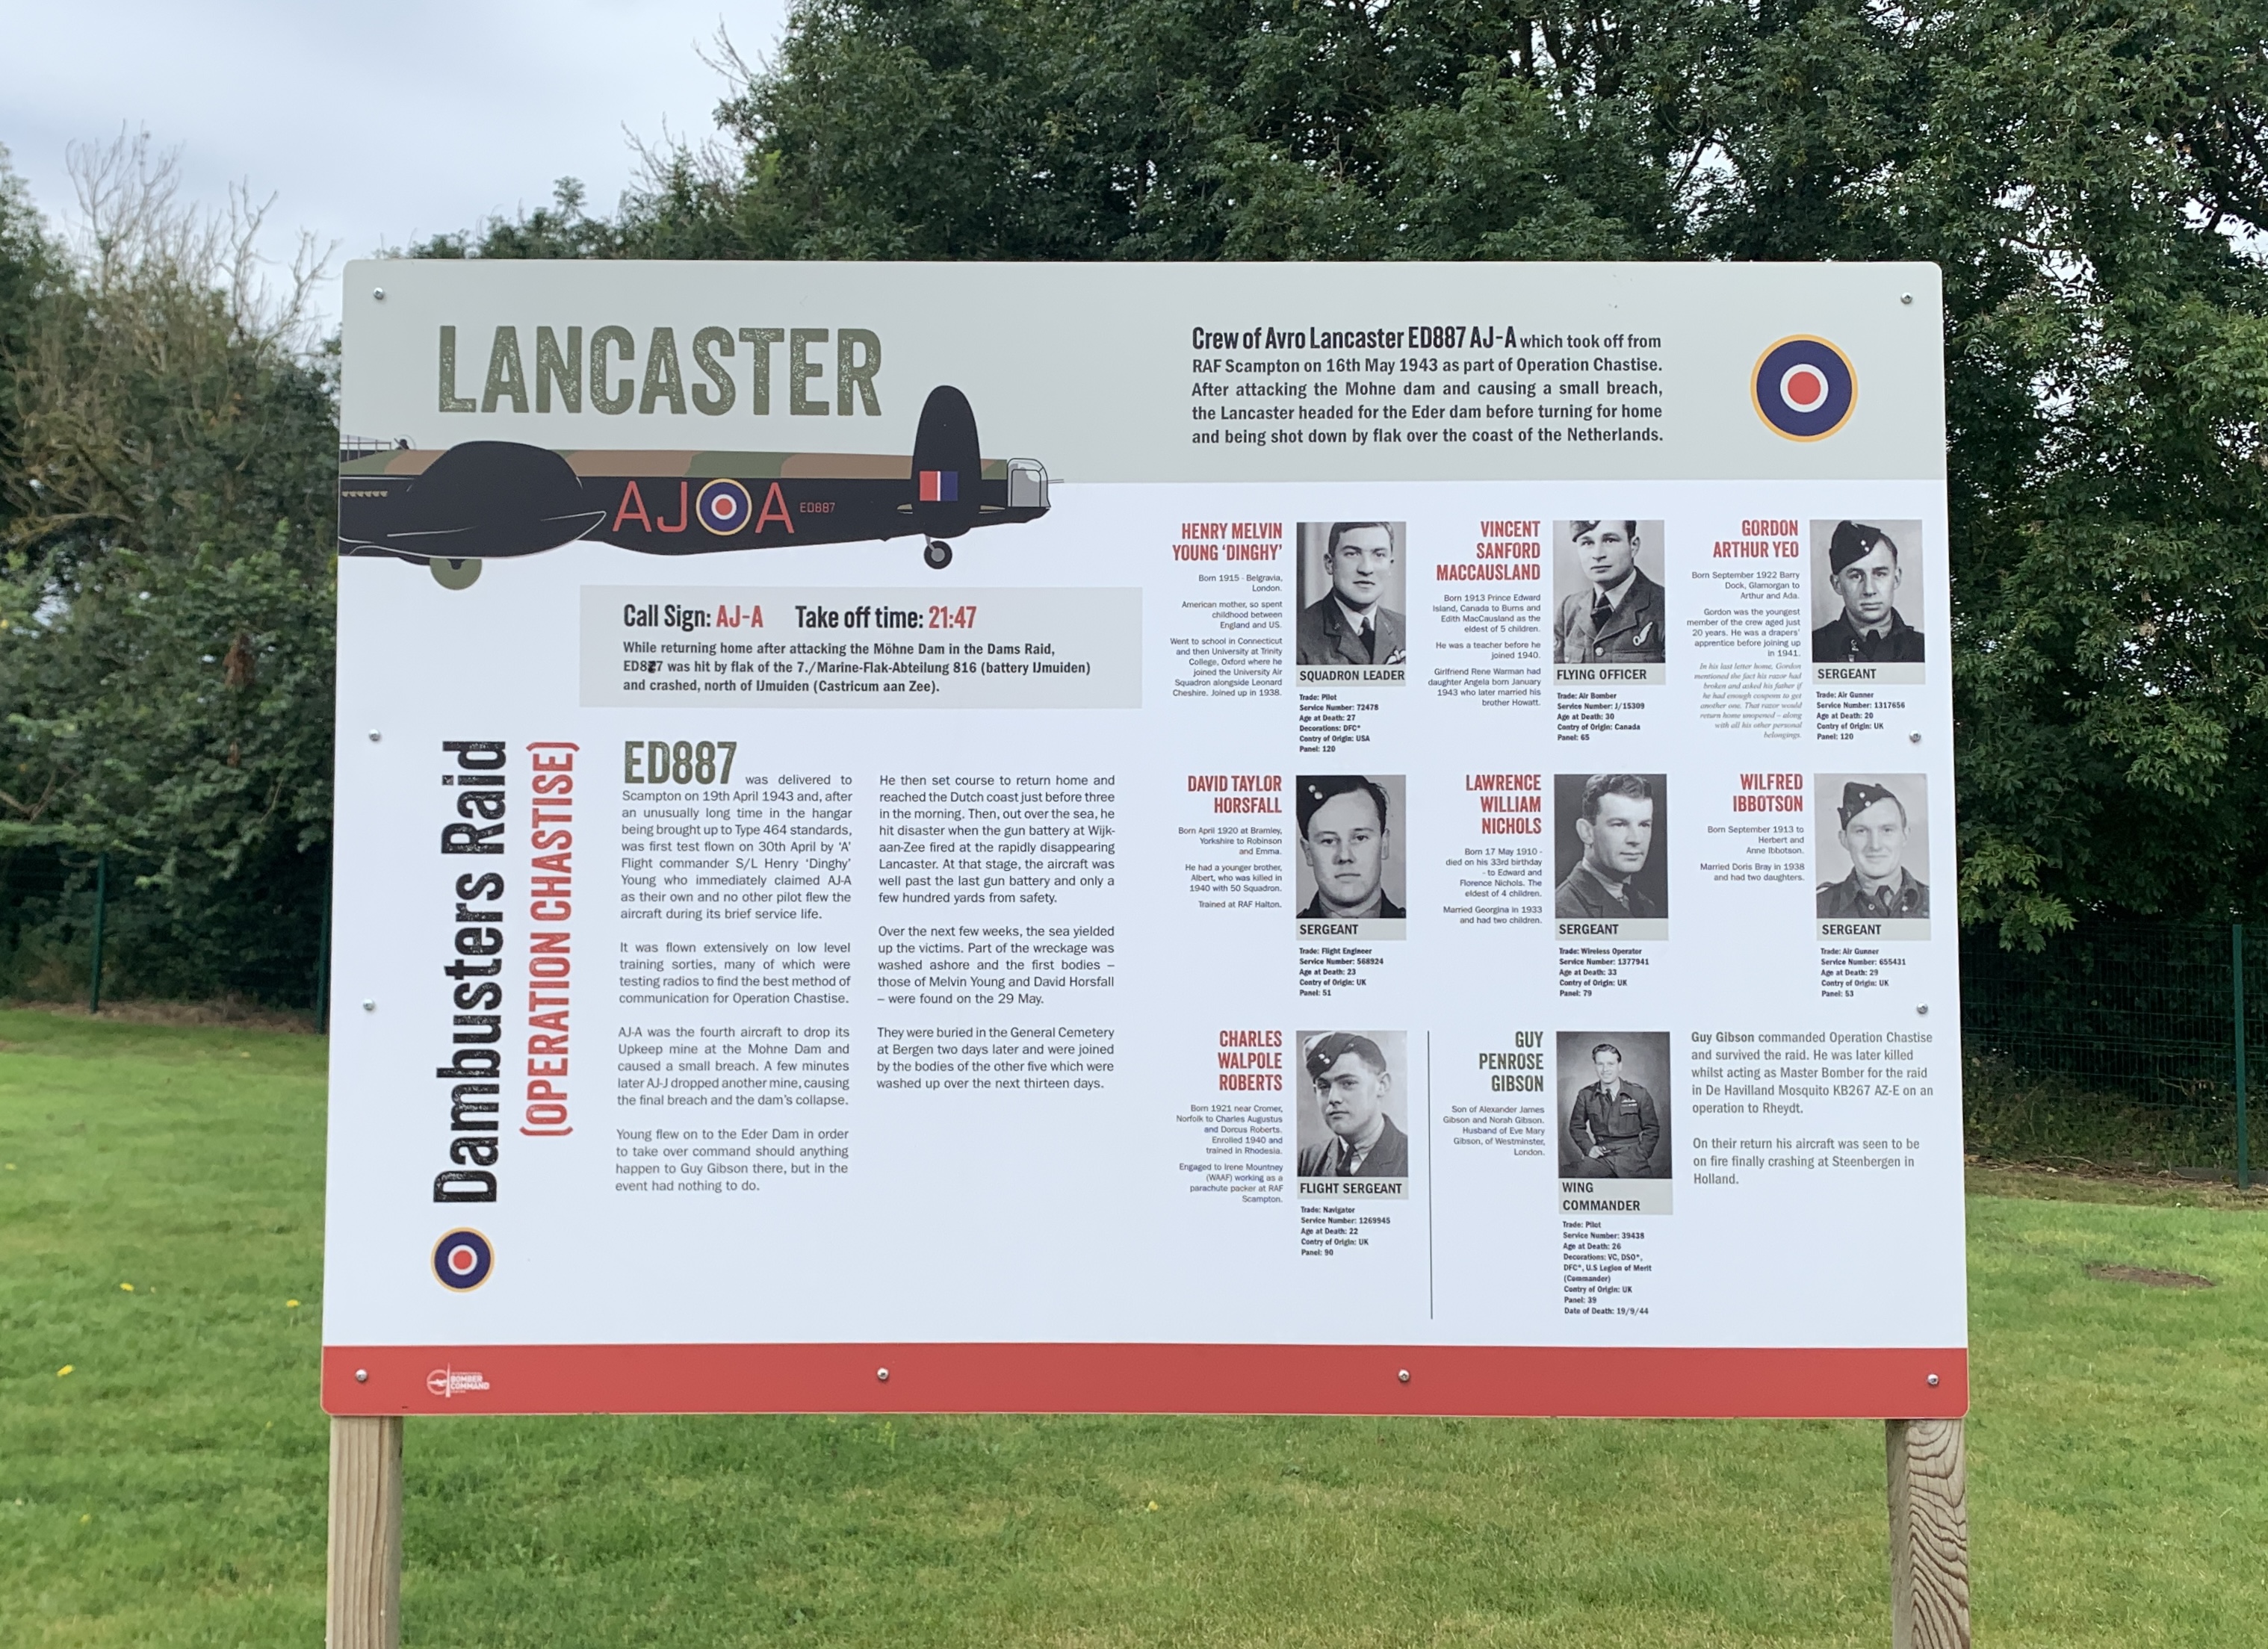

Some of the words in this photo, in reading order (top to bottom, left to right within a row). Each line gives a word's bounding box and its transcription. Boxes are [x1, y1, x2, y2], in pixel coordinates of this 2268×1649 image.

[1192, 326, 1239, 350] Crew
[1243, 327, 1262, 350] of
[1265, 327, 1306, 349] Avro
[1310, 326, 1404, 349] Lancaster
[1408, 326, 1466, 349] ED887
[1469, 326, 1516, 348] AJ-A
[1520, 335, 1563, 348] which
[1567, 335, 1599, 348] took
[1604, 334, 1624, 348] off
[1627, 334, 1661, 348] from
[439, 325, 882, 416] LANCASTER
[1193, 359, 1222, 373] RAF
[1225, 359, 1299, 376] Scampton
[1304, 361, 1322, 373] on
[1327, 358, 1360, 372] 16th
[1366, 358, 1395, 375] May
[1400, 358, 1438, 372] 1943
[1443, 361, 1459, 372] as
[1463, 358, 1495, 375] part
[1498, 357, 1513, 371] of
[1516, 358, 1589, 374] Operation
[1593, 357, 1662, 371] Chastise.
[800, 502, 835, 513] ED887
[1182, 523, 1228, 539] HENRY
[1232, 523, 1282, 539] MELVIN
[1481, 521, 1540, 537] VINCENT
[1742, 520, 1798, 536] GORDON
[1172, 544, 1218, 561] YOUNG
[1222, 544, 1282, 561] ‘DINGHY’
[1476, 542, 1540, 559] SANFORD
[1713, 541, 1769, 558] ARTHUR
[1773, 541, 1799, 558] YEO
[1437, 564, 1540, 581] MACCAUSLAND
[1712, 571, 1754, 580] September
[1779, 571, 1800, 580] Barry
[624, 604, 658, 627] Call
[664, 604, 710, 632] Sign:
[716, 605, 763, 627] AJ-A
[795, 606, 839, 628] Take
[844, 606, 871, 628] off
[875, 606, 923, 629] time:
[929, 606, 976, 628] 21:47
[623, 642, 657, 653] While
[661, 642, 716, 656] returning
[720, 642, 752, 653] home
[757, 642, 786, 654] after
[790, 643, 846, 656] attacking
[850, 643, 869, 654] the
[874, 643, 914, 654] Möhne
[918, 643, 944, 654] Dam
[949, 643, 960, 654] in
[964, 643, 983, 654] the
[988, 643, 1020, 654] Dams
[1025, 643, 1055, 656] Raid,
[1300, 671, 1359, 683] SQUADRON
[1363, 670, 1404, 680] LEADER
[1557, 669, 1595, 680] FLYING
[1599, 669, 1646, 680] OFFICER
[1818, 668, 1877, 679] SERGEANT
[625, 740, 737, 785] ED887
[746, 777, 768, 785] was
[778, 774, 831, 785] delivered
[840, 775, 852, 785] to
[880, 775, 896, 786] He
[900, 775, 926, 786] then
[932, 776, 950, 786] set
[955, 777, 994, 786] course
[1000, 776, 1011, 786] to
[1017, 776, 1050, 786] return
[1056, 775, 1088, 786] home
[1093, 775, 1115, 786] and
[1188, 775, 1228, 792] DAVID
[1231, 775, 1282, 792] TAYLOR
[1466, 774, 1541, 791] LAWRENCE
[1740, 774, 1803, 790] WILFRED
[441, 741, 506, 854] Raid
[622, 790, 681, 803] Scampton
[703, 791, 730, 801] 19th
[733, 791, 758, 803] April
[763, 791, 793, 801] 1943
[797, 791, 822, 803] and,
[825, 791, 853, 801] after
[1480, 796, 1541, 813] WILLIAM
[1733, 795, 1803, 812] IBBOTSON
[1214, 797, 1282, 813] HORSFALL
[526, 742, 580, 921] CHASTISE)
[1198, 827, 1215, 835] April
[1251, 827, 1282, 836] Bramley,
[1482, 817, 1542, 834] NICHOLS
[1300, 924, 1359, 935] SERGEANT
[1559, 924, 1619, 934] SERGEANT
[1822, 925, 1881, 935] SERGEANT
[1612, 948, 1642, 956] Operator
[433, 872, 504, 1203] Dambusters
[519, 932, 573, 1136] (OPERATION
[877, 1027, 905, 1040] They
[906, 1029, 934, 1037] were
[937, 1027, 973, 1037] buried
[976, 1027, 986, 1037] in
[988, 1027, 1008, 1037] the
[1010, 1027, 1056, 1037] General
[1059, 1027, 1115, 1040] Cemetery
[1220, 1030, 1282, 1047] CHARLES
[1515, 1031, 1543, 1048] GUY
[1691, 1031, 1712, 1045] Guy
[1716, 1031, 1754, 1043] Gibson
[1759, 1031, 1825, 1043] commanded
[1829, 1031, 1883, 1045] Operation
[1886, 1031, 1933, 1043] Chastise
[1218, 1052, 1282, 1069] WALPOLE
[1479, 1053, 1544, 1070] PENROSE
[1219, 1074, 1283, 1091] ROBERTS
[1492, 1075, 1543, 1092] GIBSON
[1301, 1183, 1339, 1193] FLIGHT
[1343, 1183, 1402, 1193] SERGEANT
[1562, 1182, 1593, 1193] WING
[1323, 1206, 1355, 1214] Navigator
[1563, 1200, 1640, 1211] COMMANDER
[1617, 1308, 1649, 1316] 19/9/44
